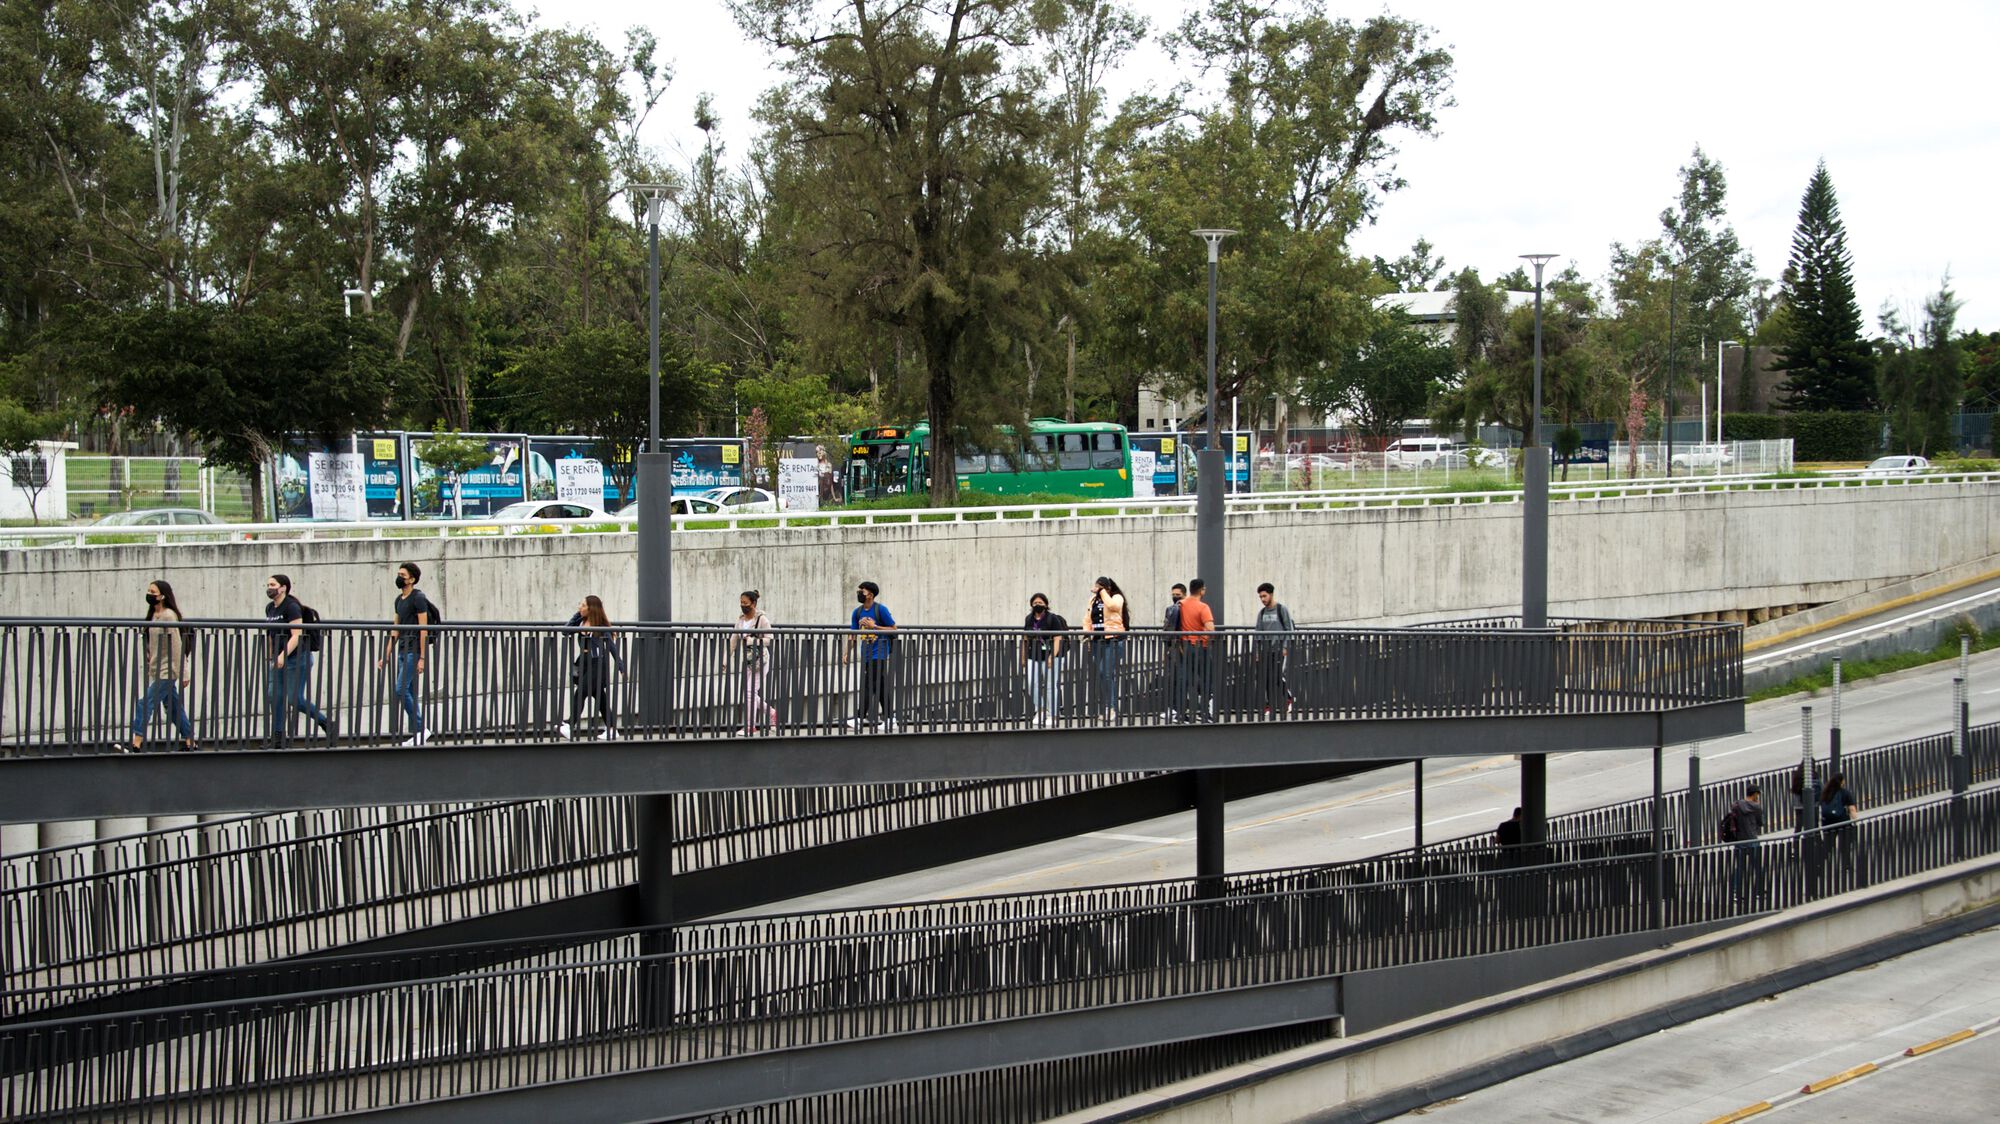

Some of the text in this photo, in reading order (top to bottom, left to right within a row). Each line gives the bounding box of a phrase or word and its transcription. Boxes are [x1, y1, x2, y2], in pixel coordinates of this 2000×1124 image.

[314, 460, 361, 470] SE RENT
[561, 464, 600, 475] SE RENTA
[792, 464, 815, 473] RENTA
[321, 484, 329, 493] 33
[566, 488, 573, 496] 33
[574, 488, 588, 496] 1720
[588, 487, 602, 495] 9449
[793, 485, 805, 493] 1720
[887, 484, 906, 494] 641
